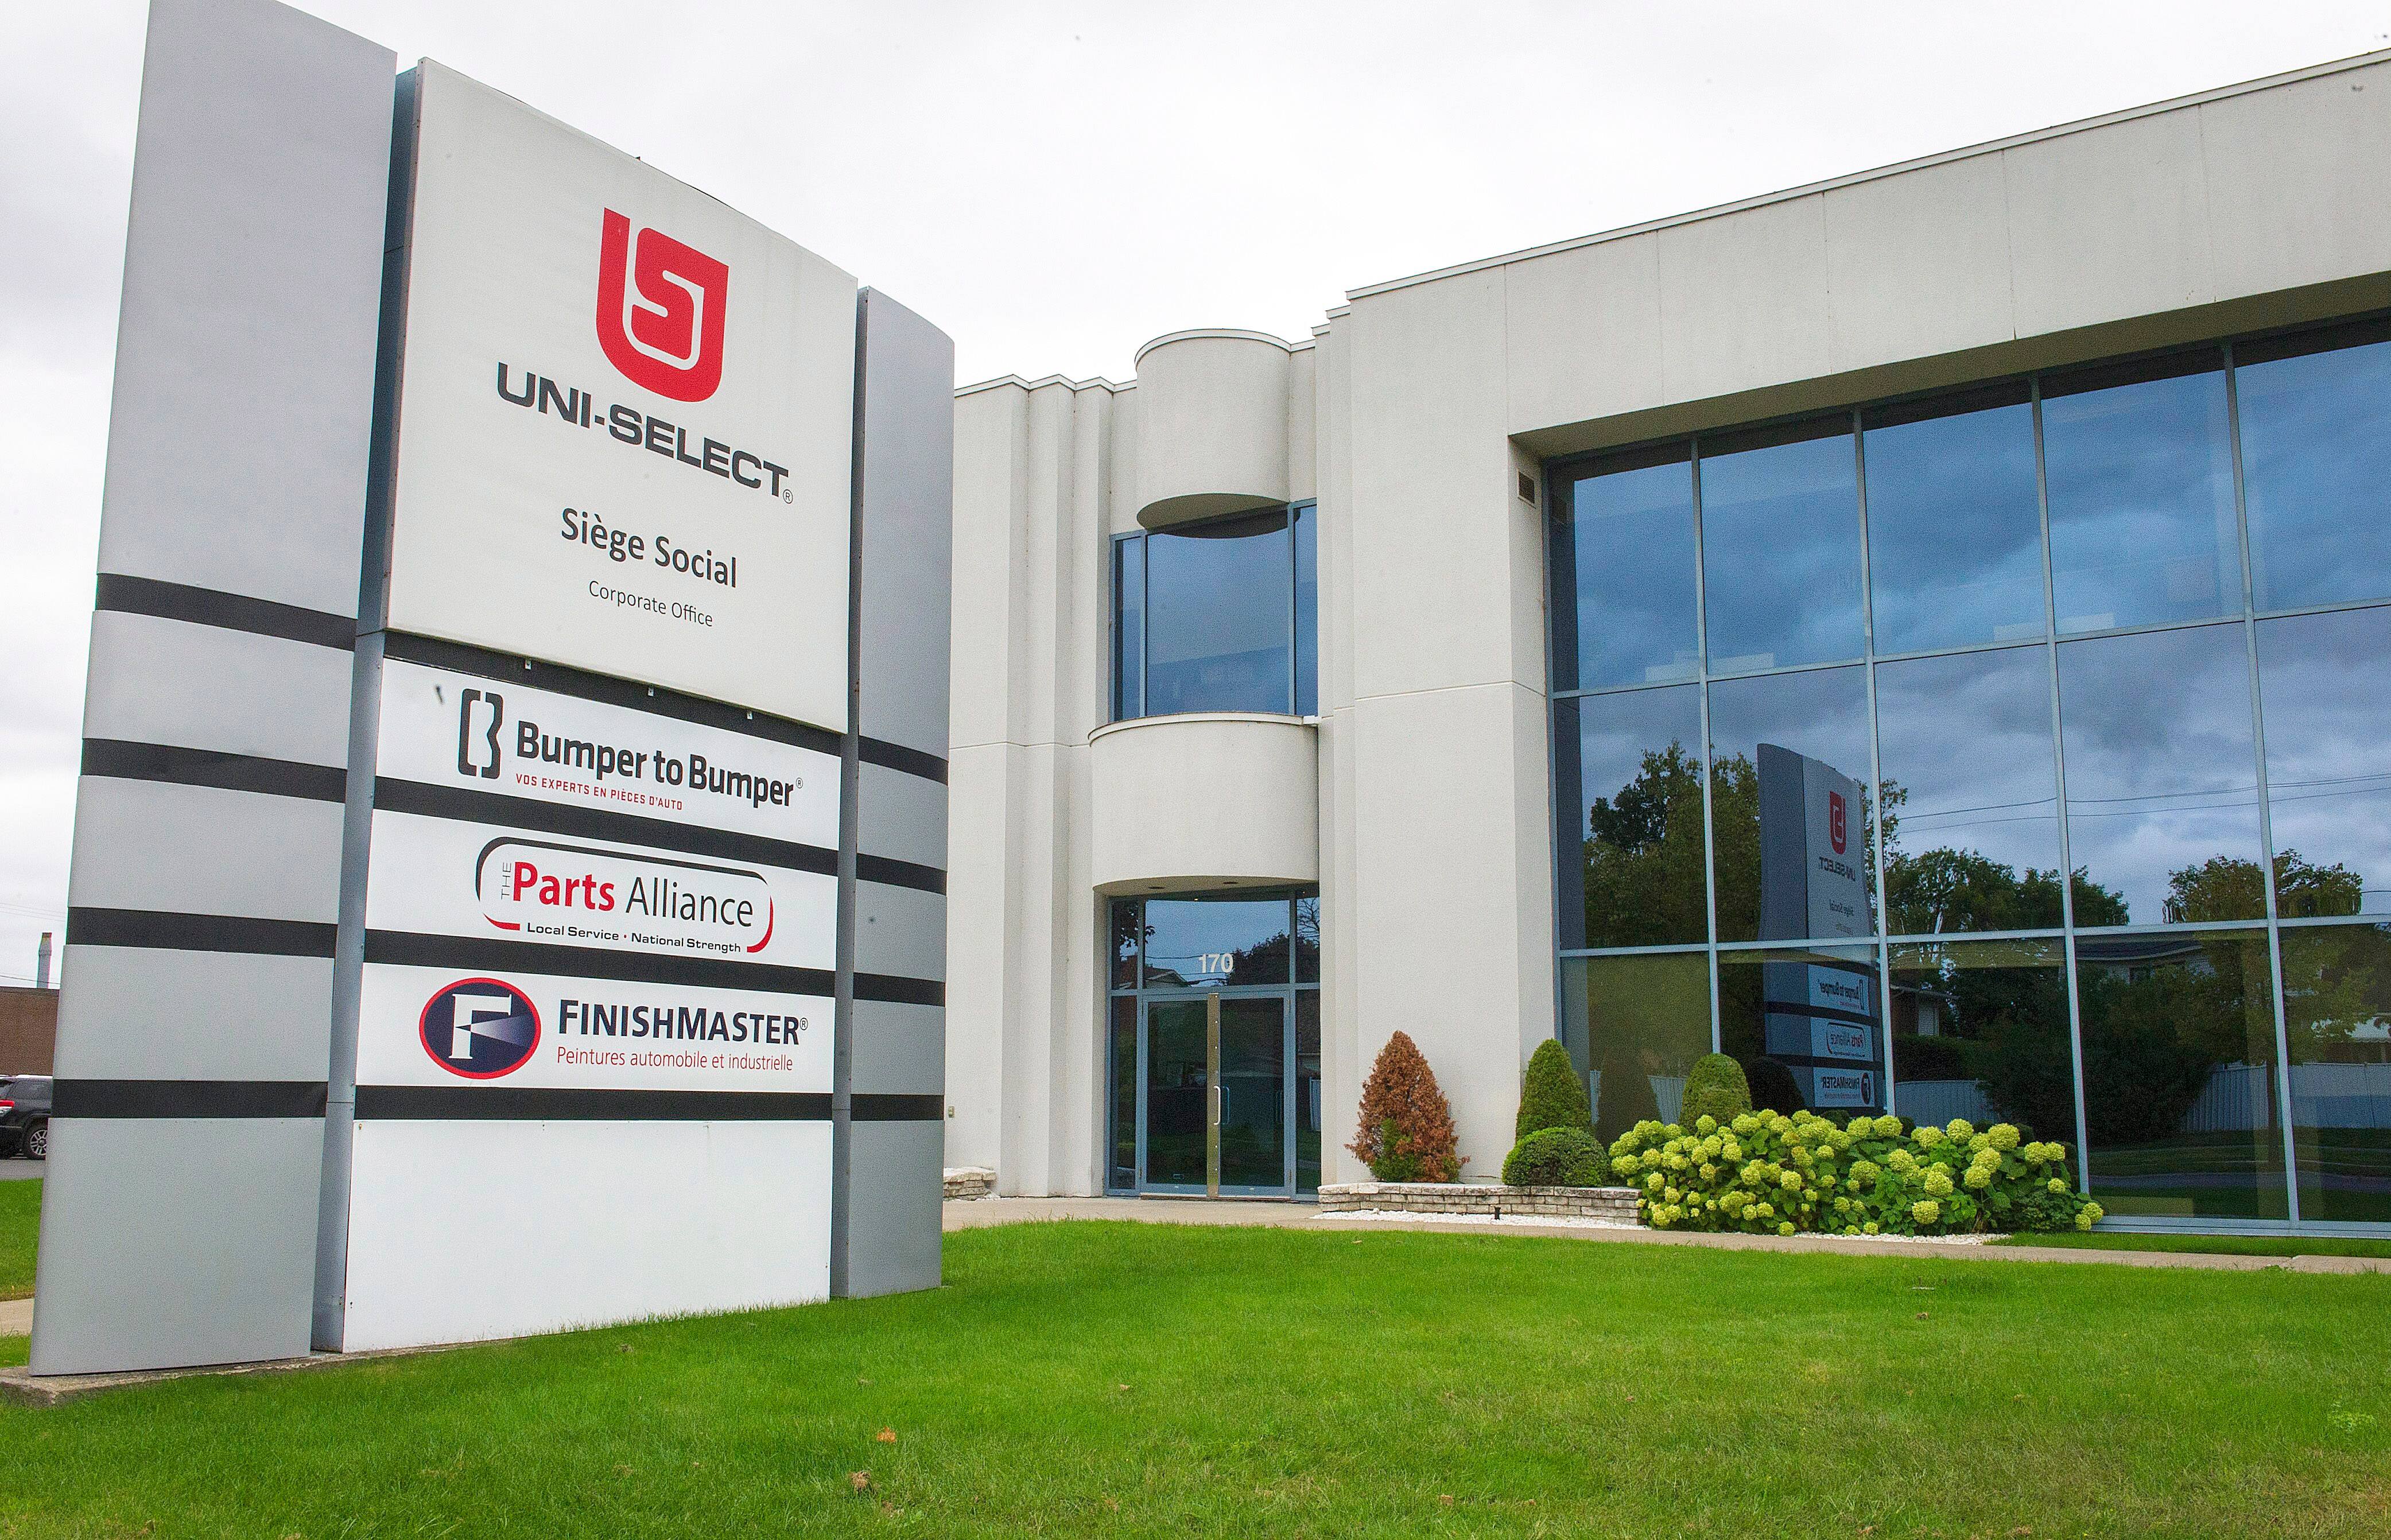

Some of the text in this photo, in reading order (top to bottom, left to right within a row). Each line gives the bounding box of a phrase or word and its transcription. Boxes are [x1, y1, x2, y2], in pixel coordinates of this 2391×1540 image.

[562, 508, 736, 588] Siège Social
[589, 581, 712, 627] Corporate Office
[517, 720, 647, 780] Bumper
[653, 750, 683, 785] to
[516, 774, 682, 810] VOS EXPERTS EN PIÈCES D'AUTO
[501, 863, 511, 899] THE
[513, 862, 752, 926] Parts Alliance
[527, 922, 740, 953] Local Service National Strength
[1199, 953, 1233, 973] 170
[558, 1046, 793, 1070] Peintures automobile et industrielle
